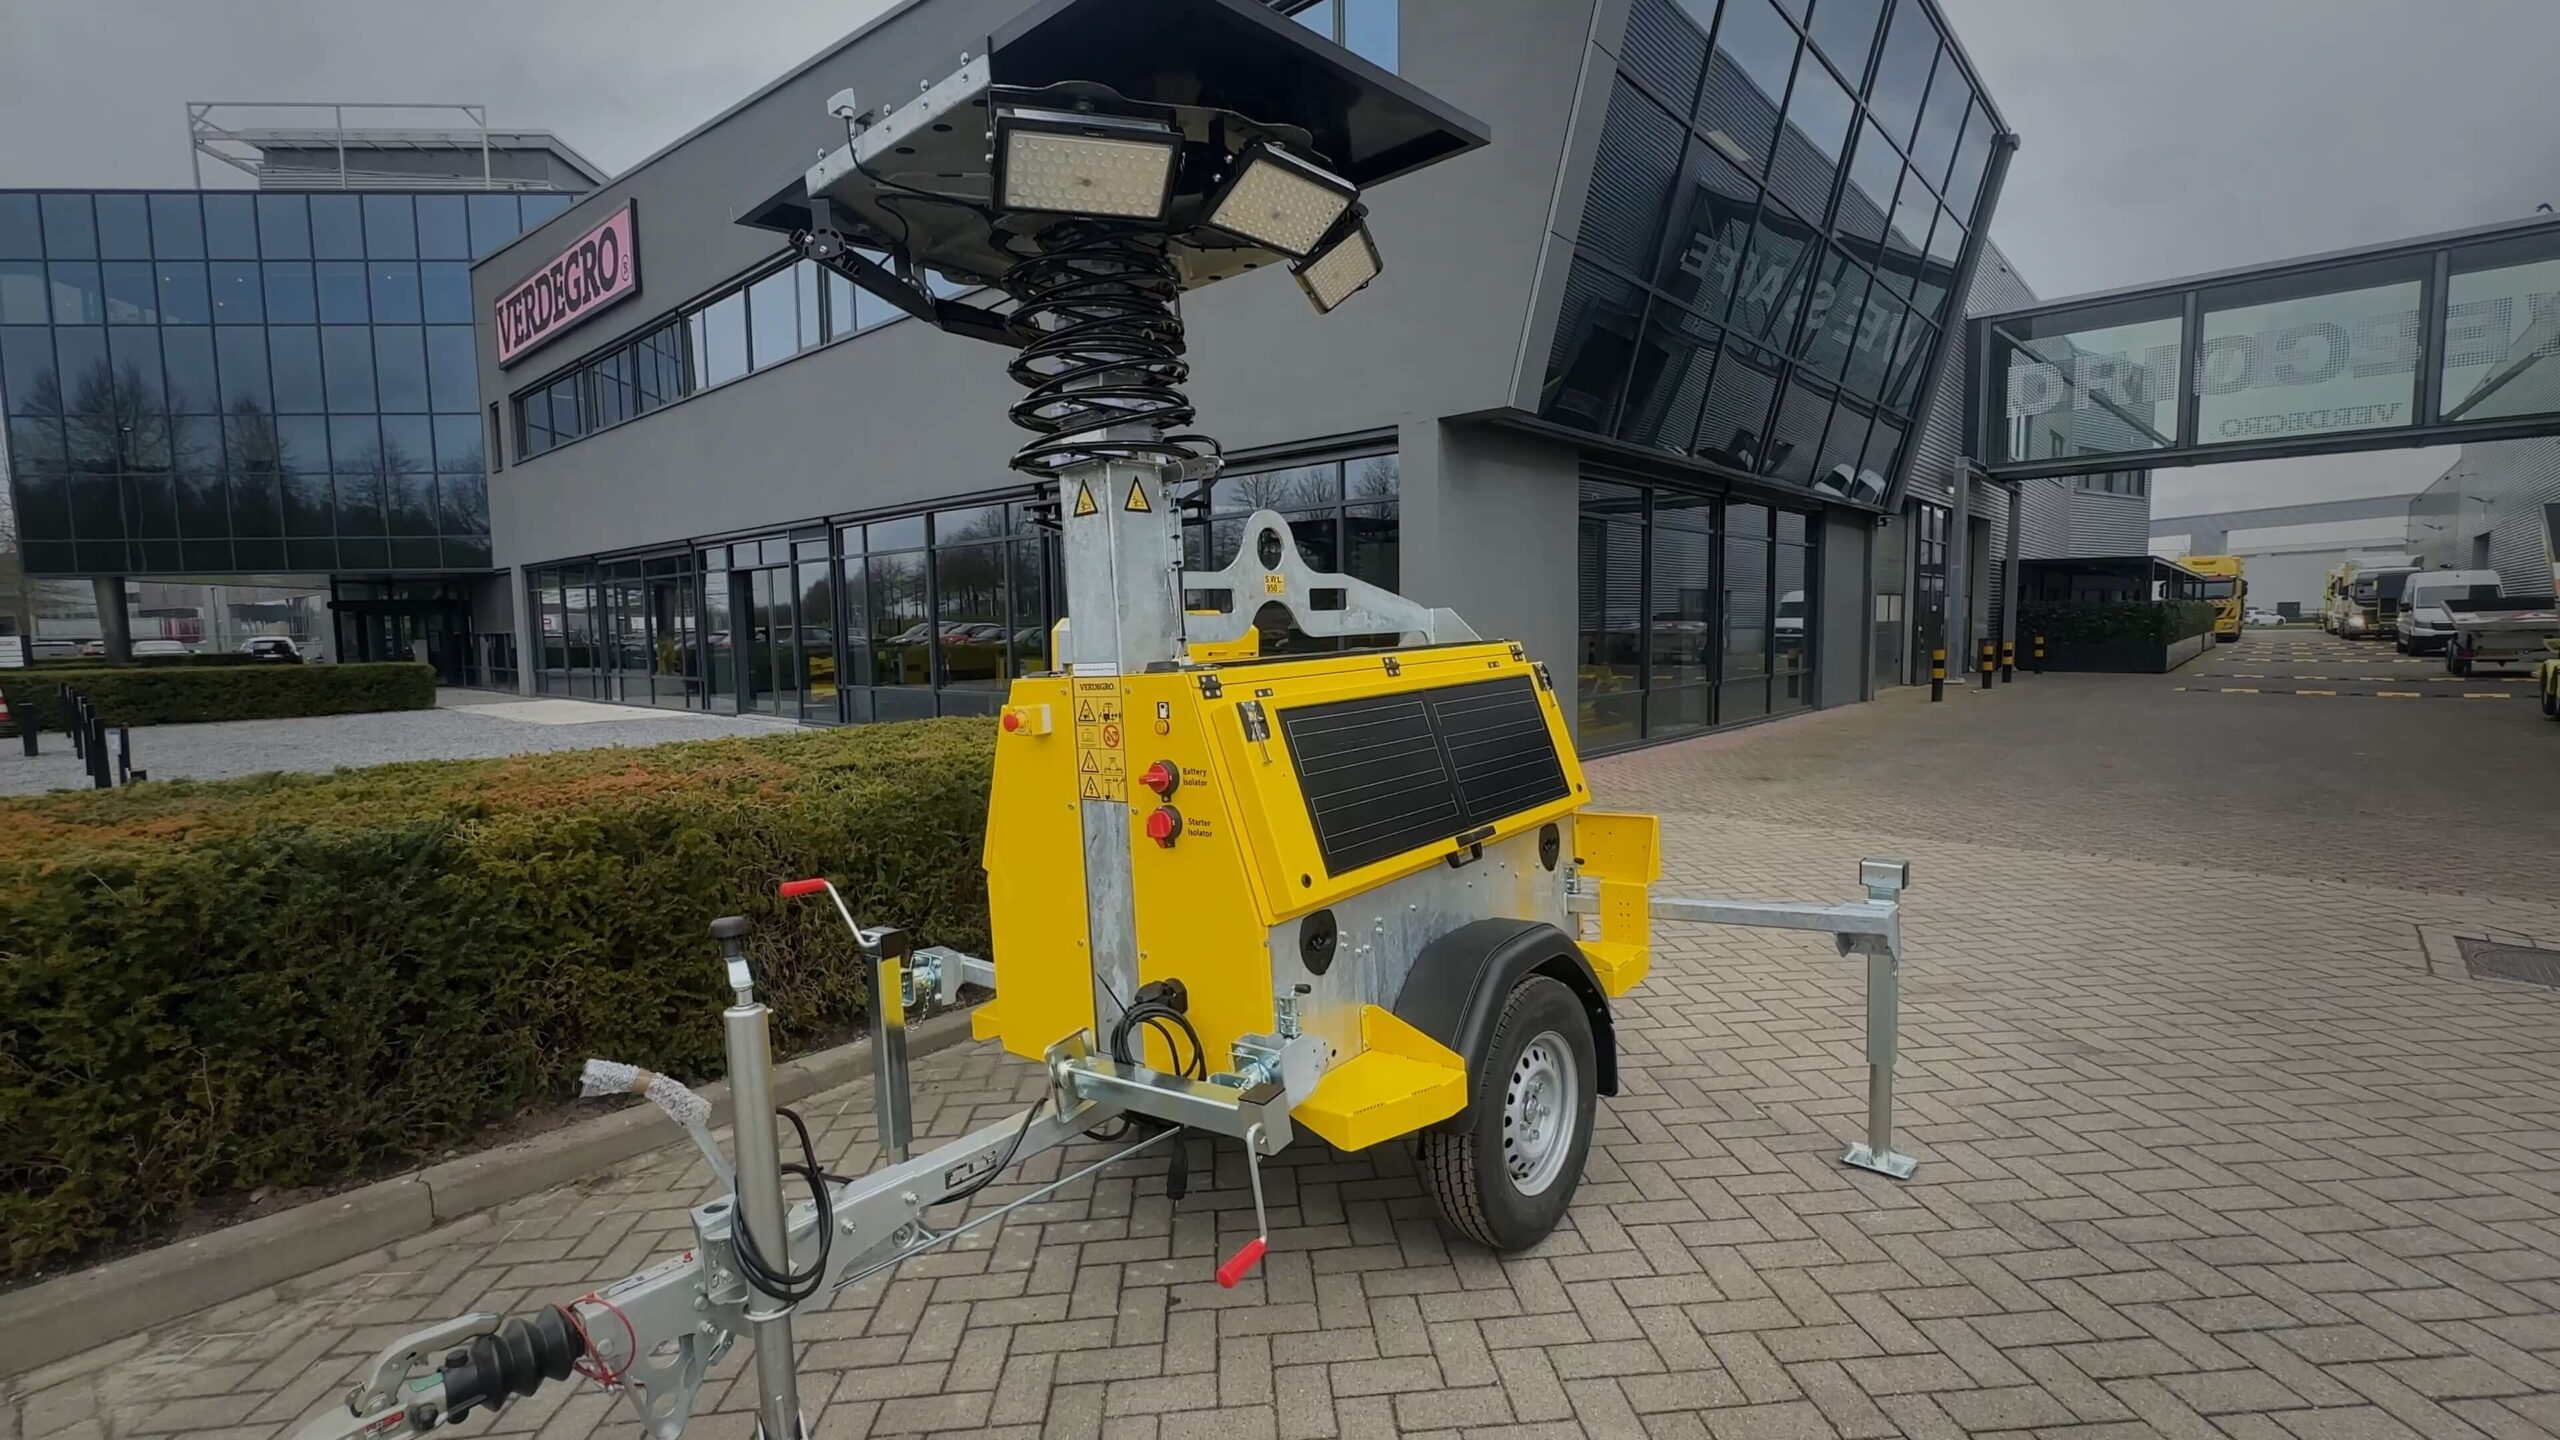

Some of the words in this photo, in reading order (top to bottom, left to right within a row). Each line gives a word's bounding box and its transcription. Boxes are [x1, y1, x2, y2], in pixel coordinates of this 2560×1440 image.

[497, 227, 619, 353] VERDEGRO
[1182, 767, 1207, 777] Battery
[1182, 778, 1208, 787] Isolator
[1187, 817, 1212, 827] Starter
[1187, 828, 1213, 838] Isolator
